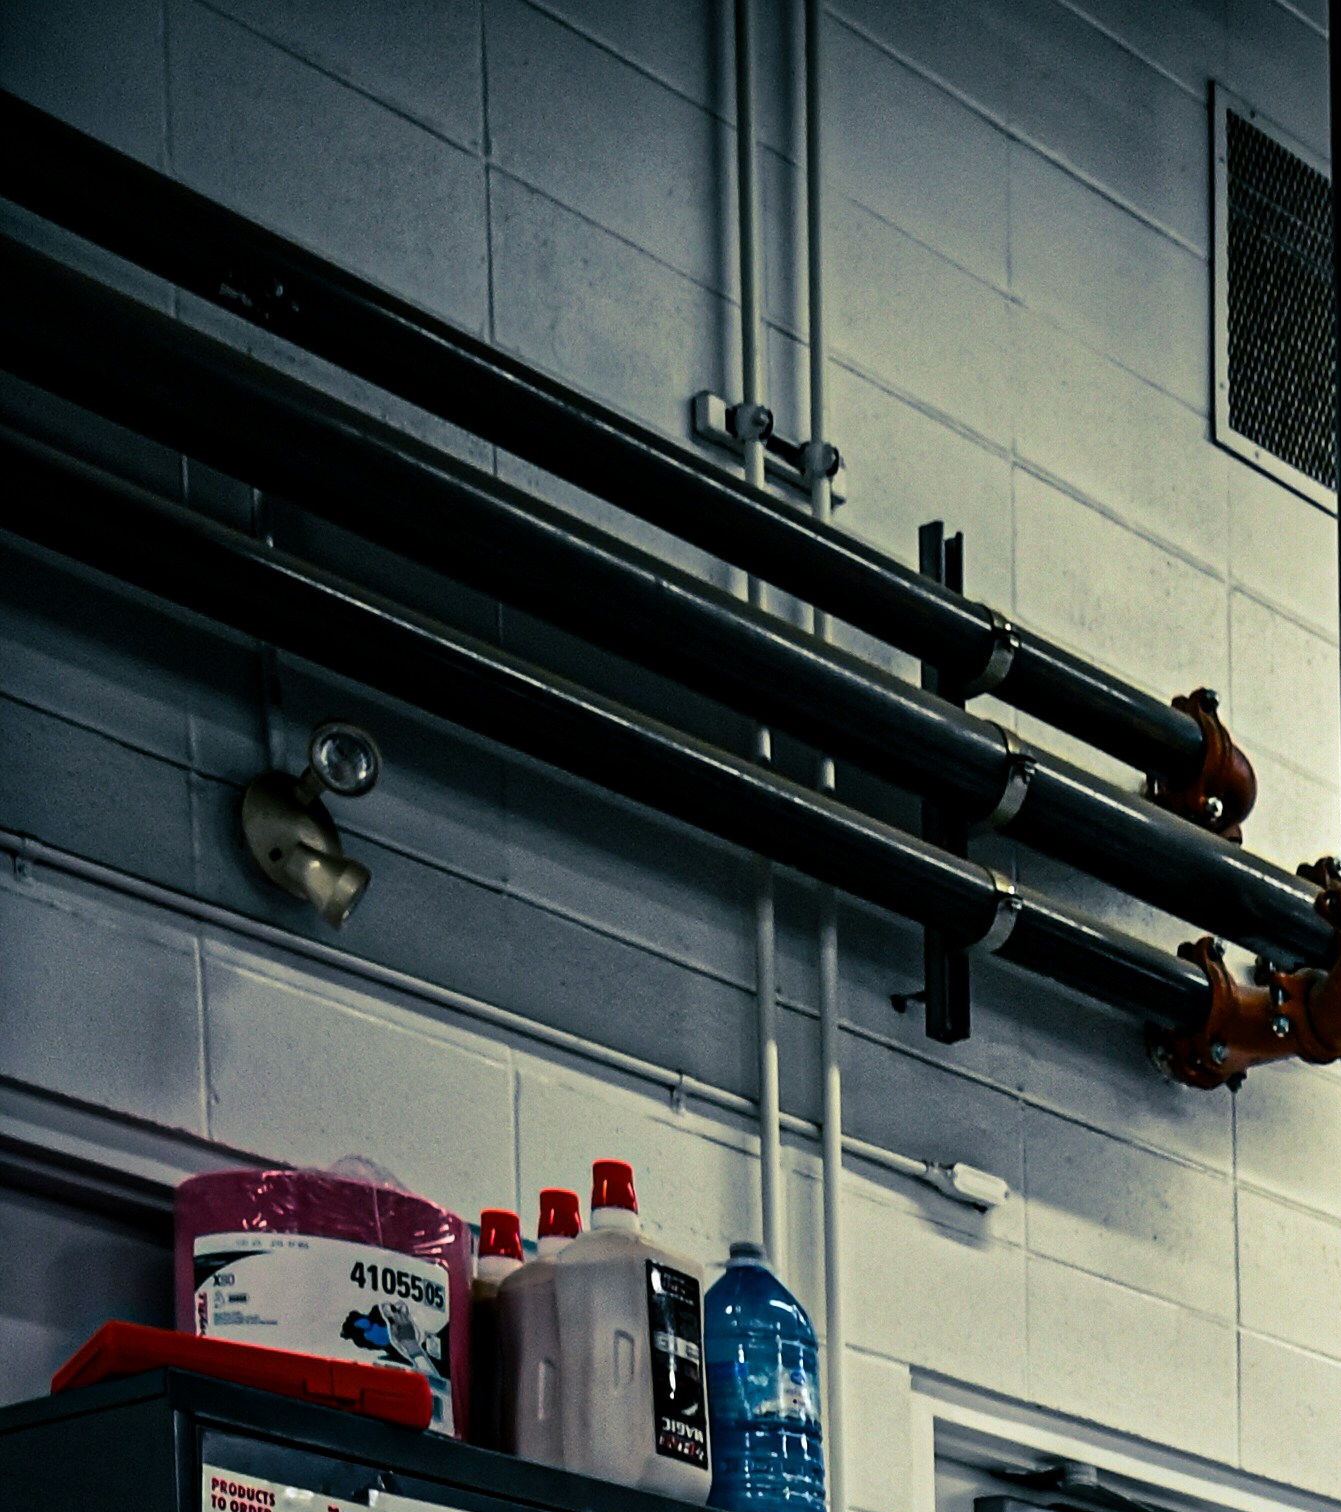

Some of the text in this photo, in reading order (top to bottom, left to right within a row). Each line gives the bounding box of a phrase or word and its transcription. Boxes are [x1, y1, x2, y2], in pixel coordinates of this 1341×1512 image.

[661, 1416, 704, 1444] MAGIC
[211, 1477, 276, 1507] PRODUCTS
[211, 1495, 227, 1511] TO
